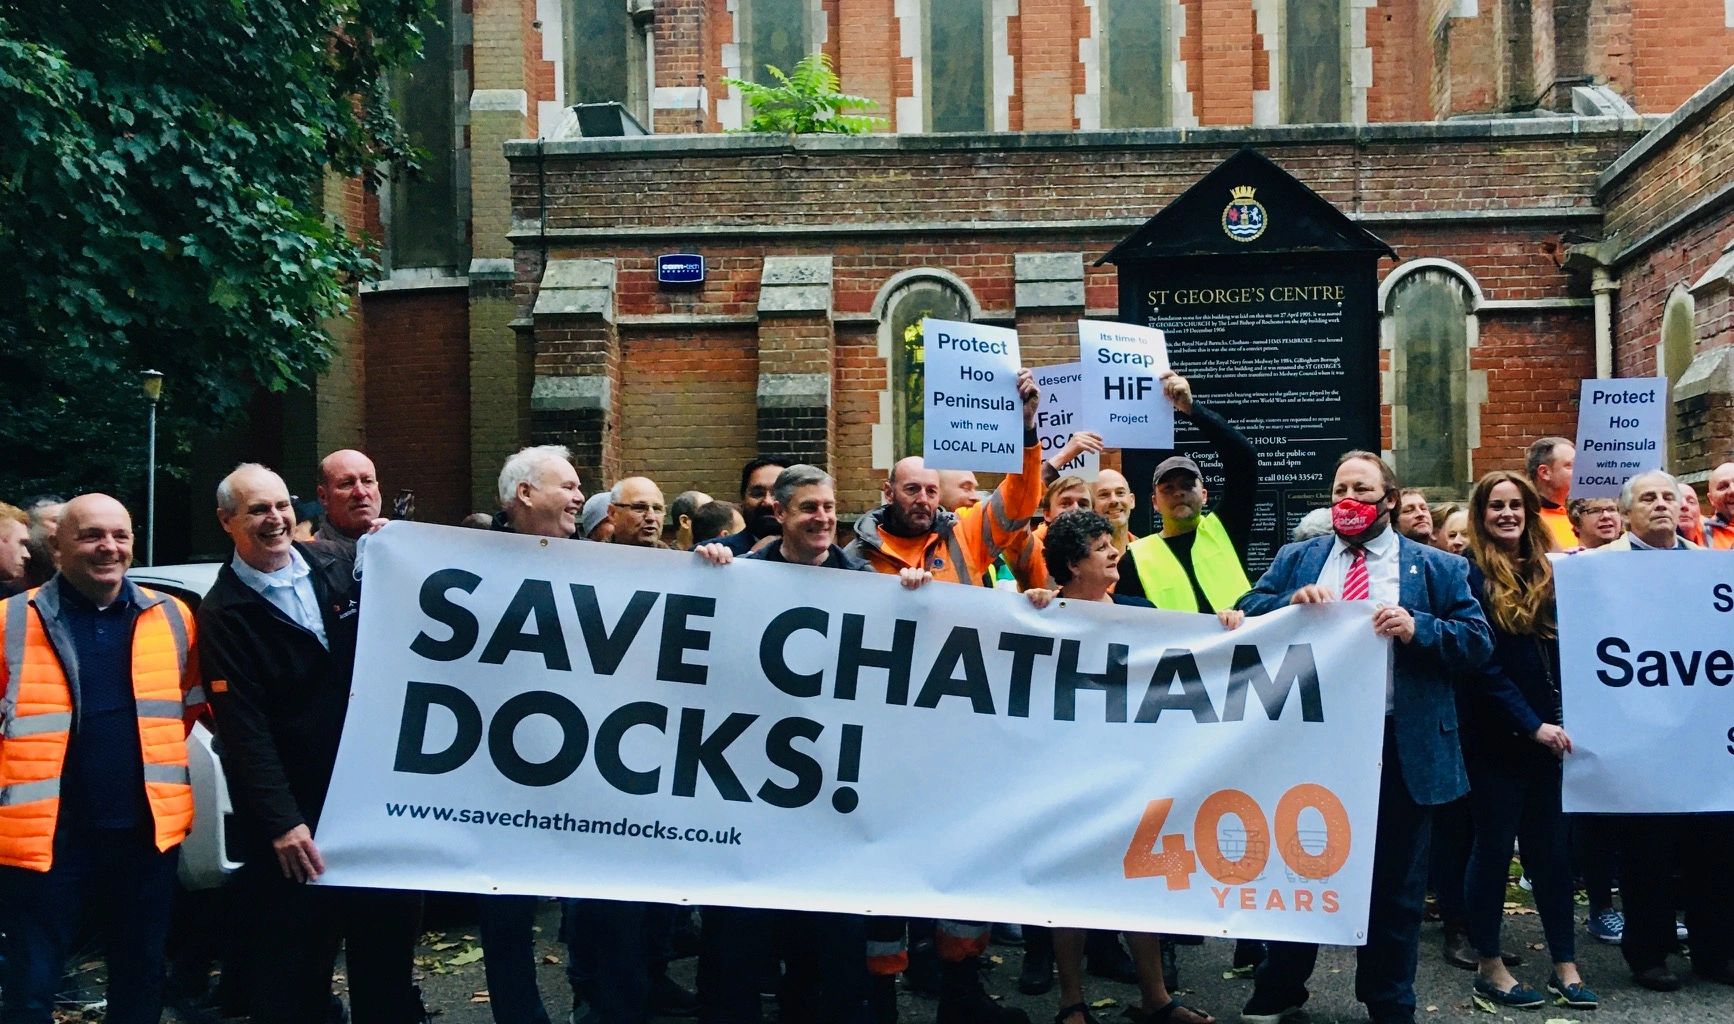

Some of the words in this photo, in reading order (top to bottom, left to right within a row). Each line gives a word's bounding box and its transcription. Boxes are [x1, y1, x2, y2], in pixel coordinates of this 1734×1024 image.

[1147, 290, 1170, 306] ST
[1269, 284, 1346, 302] CENTRE
[1212, 313, 1231, 321] building
[1287, 311, 1299, 319] April
[1239, 318, 1255, 327] Bishop
[1261, 317, 1284, 325] Rochester
[1308, 316, 1328, 325] building
[937, 332, 1009, 356] Protect
[1100, 333, 1113, 342] Its
[1115, 334, 1136, 344] time
[1139, 336, 1148, 346] to
[1097, 347, 1155, 368] Scrap
[1229, 358, 1242, 366] Navy
[1254, 357, 1274, 365] Medway
[1294, 356, 1320, 364] Gillingham
[1320, 356, 1341, 364] Borough
[960, 365, 995, 383] Hoo
[1234, 364, 1254, 372] building
[1279, 369, 1299, 378] Medway
[1103, 376, 1154, 401] HiF
[933, 391, 1016, 412] Peninsula
[1049, 393, 1058, 404] A
[1592, 389, 1656, 405] Protect
[950, 419, 974, 431] with
[976, 420, 999, 431] new
[1037, 409, 1074, 428] Fair
[1109, 412, 1149, 425] Project
[1609, 416, 1640, 429] Hoo
[933, 439, 978, 453] LOCAL
[981, 441, 1016, 455] PLAN
[1255, 436, 1288, 445] HOURS
[1583, 438, 1657, 452] Peninsula
[1274, 449, 1284, 458] the
[1286, 448, 1306, 459] public
[1199, 459, 1225, 470] Tuesday
[1273, 458, 1286, 466] and
[1286, 458, 1302, 468] 4pm
[1596, 460, 1618, 469] with
[1620, 461, 1641, 469] new
[1264, 473, 1276, 482] call
[1276, 472, 1298, 482] 01634
[1298, 472, 1324, 482] 335472
[1578, 476, 1619, 486] LOCAL
[408, 568, 717, 686] SAVE
[758, 606, 1325, 725] CHATHAM
[1596, 636, 1734, 688] Save
[393, 680, 864, 814] DOCKS!
[386, 802, 743, 846] www.savechathamdocks.co.uk
[1122, 783, 1352, 891] 400
[1210, 886, 1341, 914] YEARS
